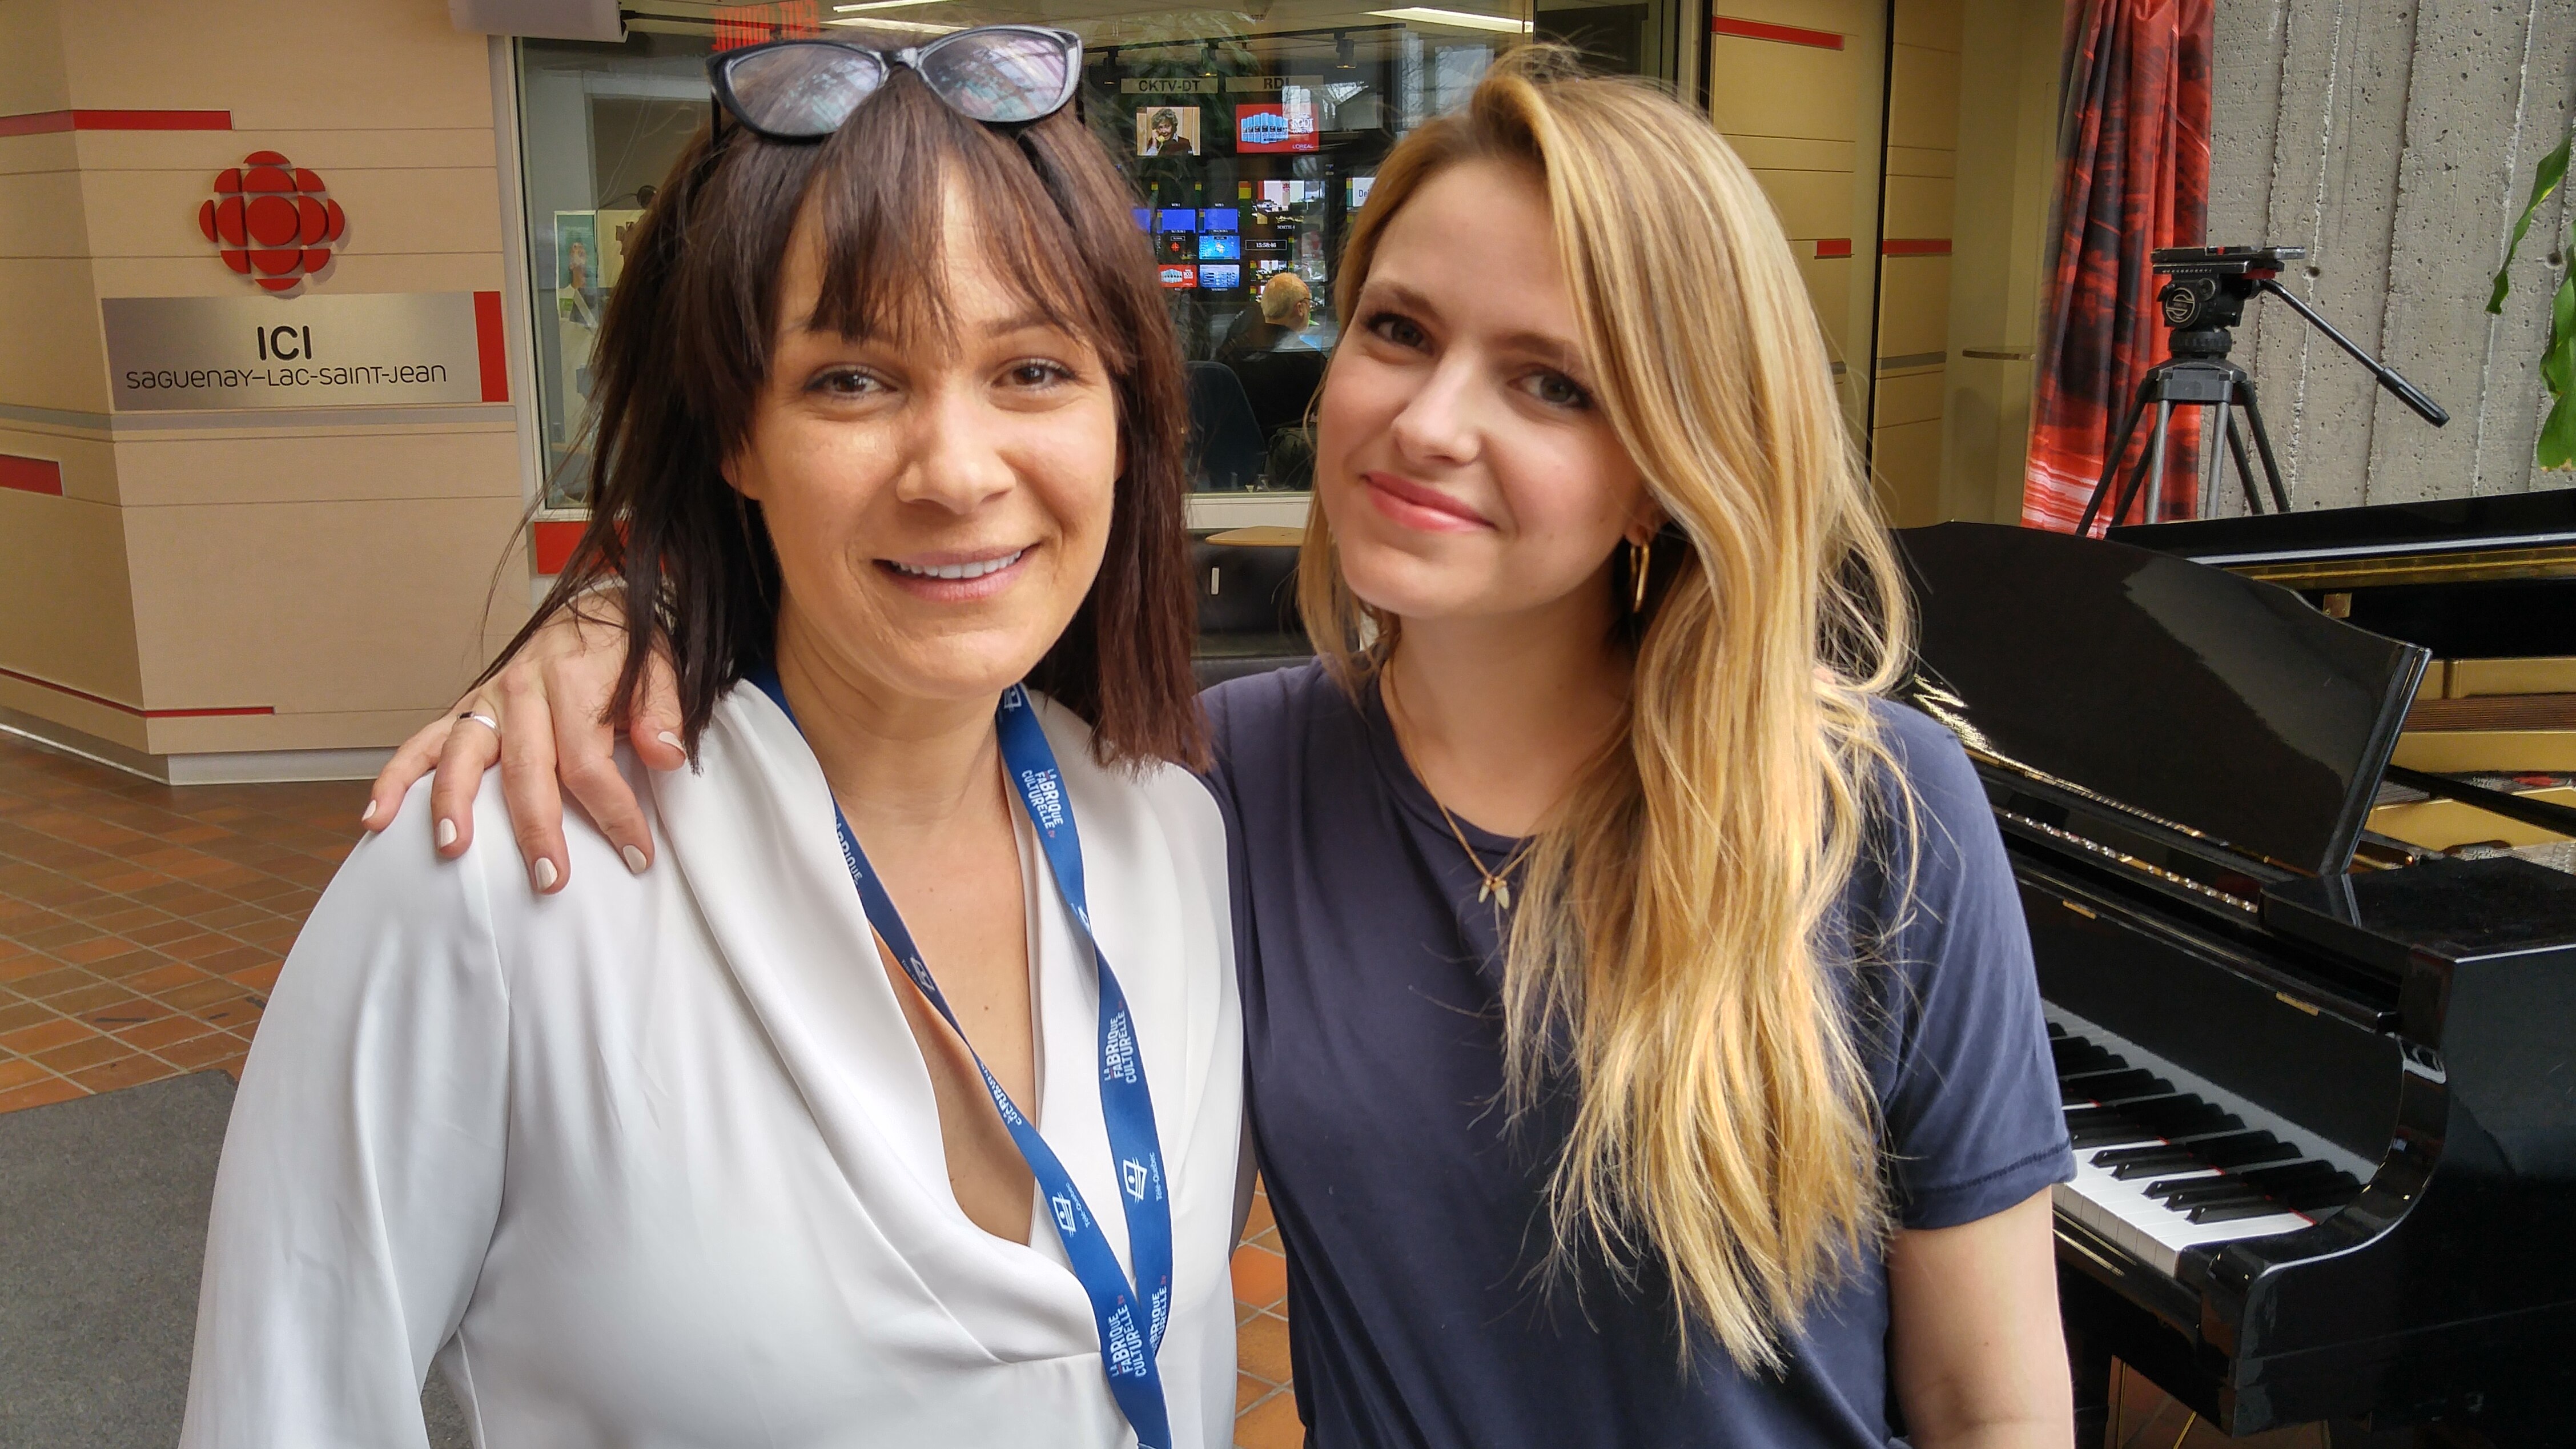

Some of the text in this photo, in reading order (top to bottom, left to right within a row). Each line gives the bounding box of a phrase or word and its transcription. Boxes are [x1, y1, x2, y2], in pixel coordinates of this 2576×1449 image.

[1139, 79, 1200, 92] CKTV-DT
[257, 325, 312, 361] ICI
[1022, 769, 1055, 829] CULTURELLE
[1035, 771, 1064, 825] FABRIQUE
[1047, 768, 1057, 780] LA
[1106, 1015, 1124, 1078] FABRIQUE
[1118, 1010, 1137, 1083] CULTURELLE
[1103, 1067, 1111, 1081] LA
[1108, 1312, 1134, 1374] FABRIQUE
[1118, 1304, 1147, 1377] CULTURELLE
[1110, 1364, 1119, 1377] LA
